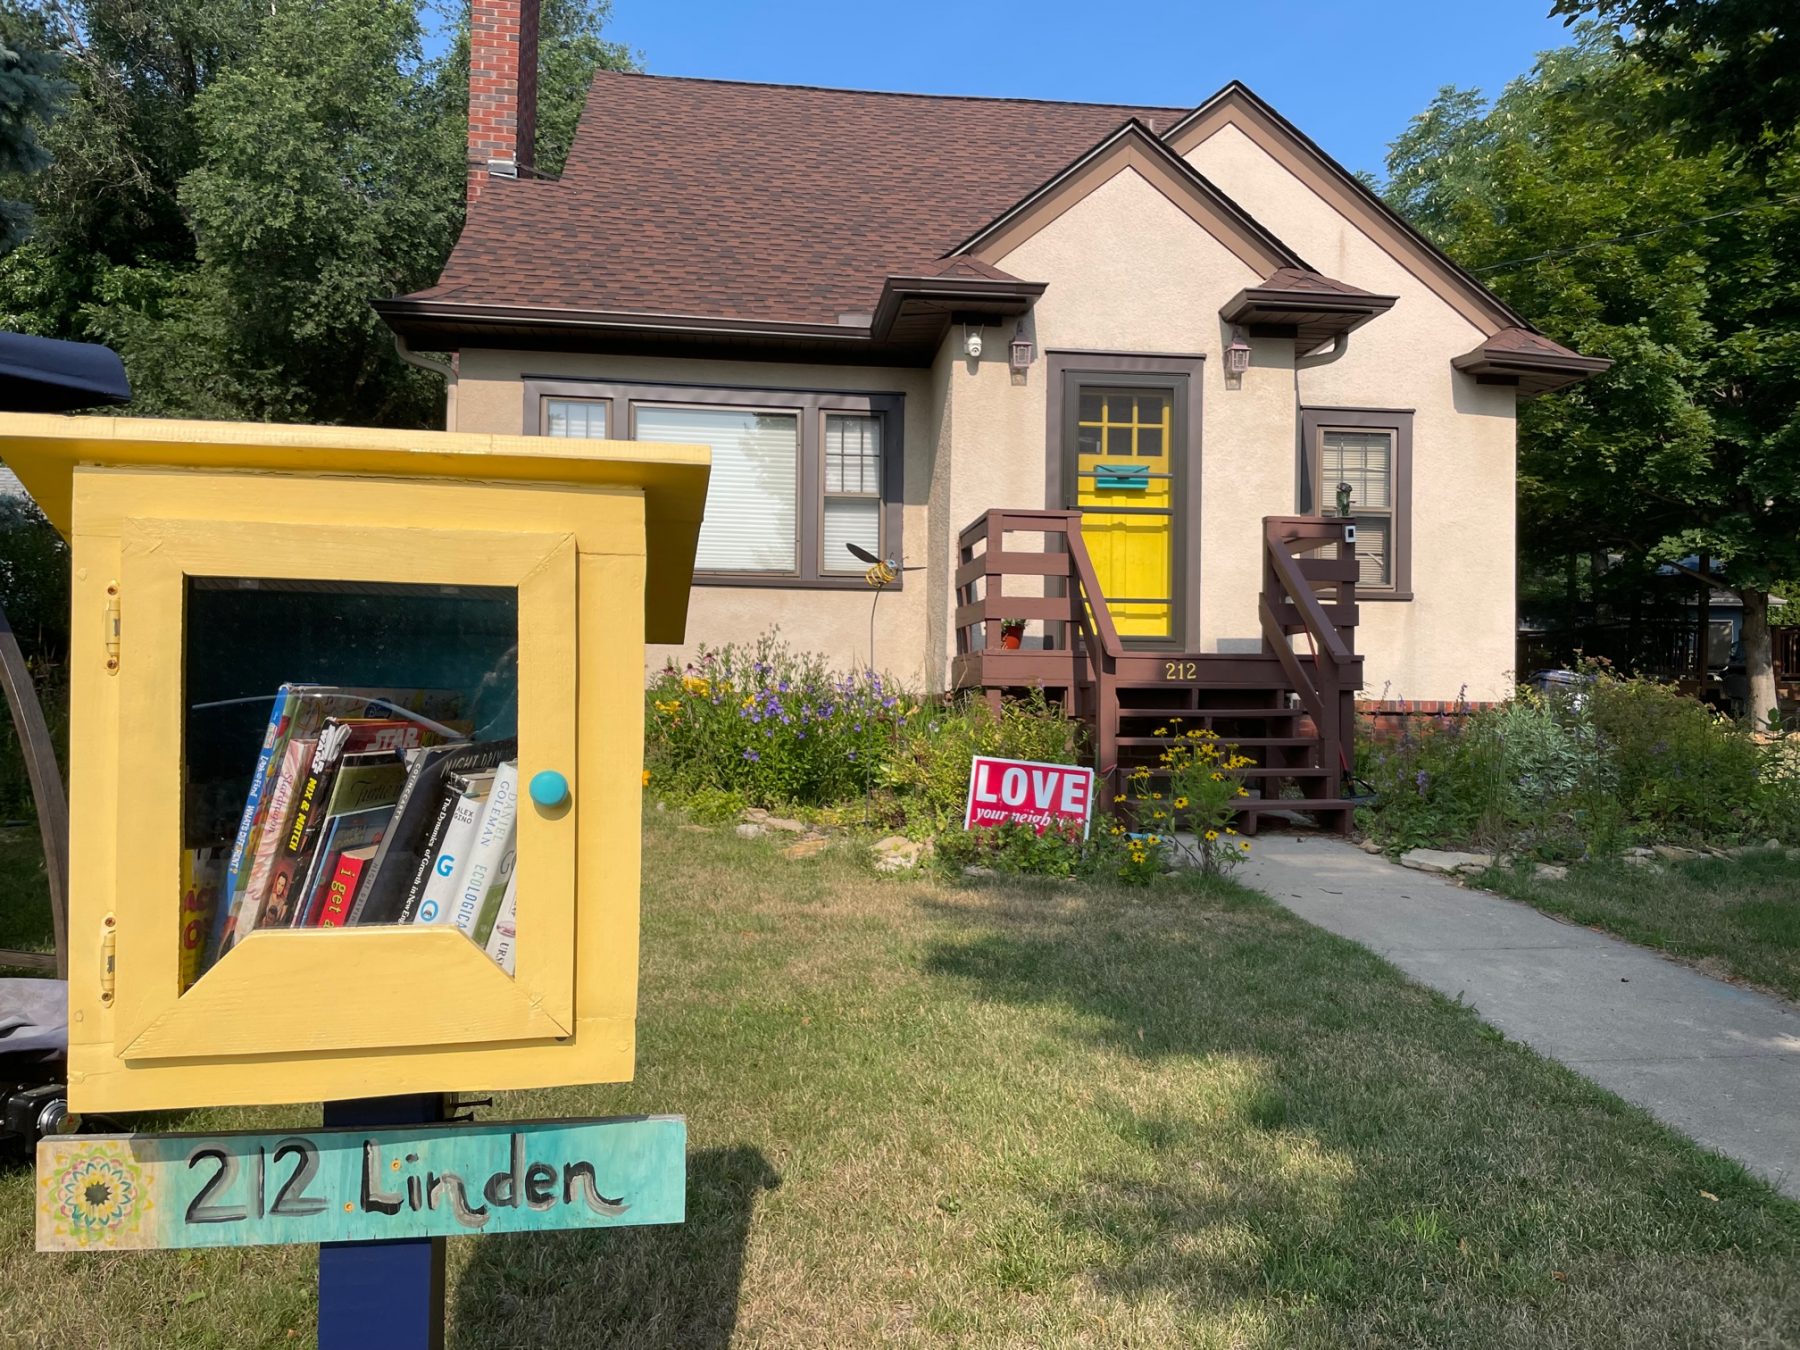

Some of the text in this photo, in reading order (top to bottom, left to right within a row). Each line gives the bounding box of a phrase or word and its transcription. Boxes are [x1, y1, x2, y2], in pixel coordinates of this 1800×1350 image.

[1165, 662, 1197, 680] 212
[364, 727, 418, 752] STAR
[440, 753, 479, 779] NIGHT
[975, 764, 1087, 813] LOVE
[288, 777, 317, 851] MIX & MATCH
[441, 797, 452, 812] The
[456, 807, 474, 817] ALEX
[480, 780, 510, 847] GOLEMAN
[493, 792, 518, 841] DANIEL
[972, 807, 1009, 823] your
[428, 811, 447, 847] Dynamics
[454, 813, 472, 825] GINO
[424, 848, 431, 858] of
[413, 857, 430, 885] Growth
[328, 881, 346, 913] get
[404, 894, 416, 911] New
[410, 885, 419, 895] in
[184, 1132, 631, 1229] 212 Linden
